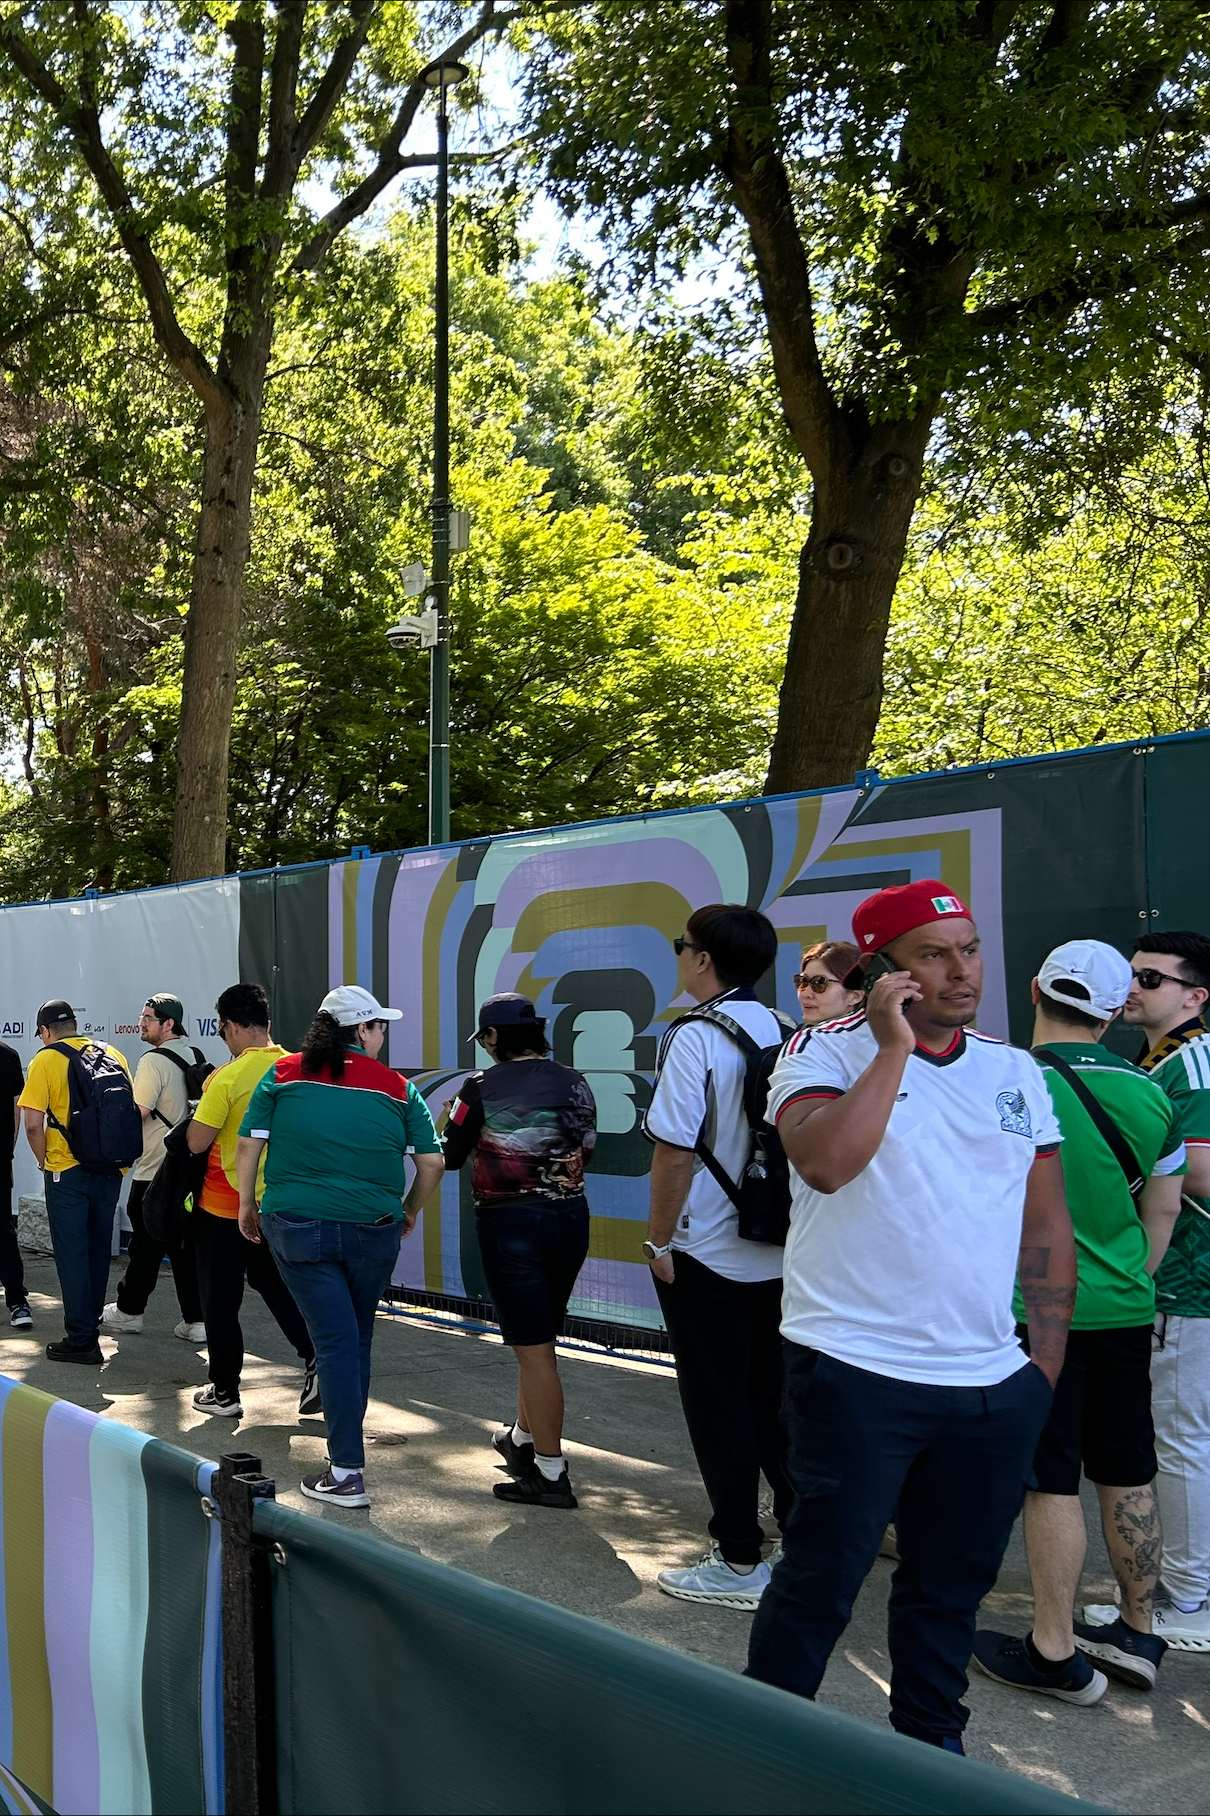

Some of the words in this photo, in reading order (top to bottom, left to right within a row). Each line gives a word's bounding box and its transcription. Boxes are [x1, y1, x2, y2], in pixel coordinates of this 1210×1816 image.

[2, 1021, 24, 1034] ADI
[114, 1023, 140, 1034] Lenovo
[196, 1018, 219, 1037] VIS
